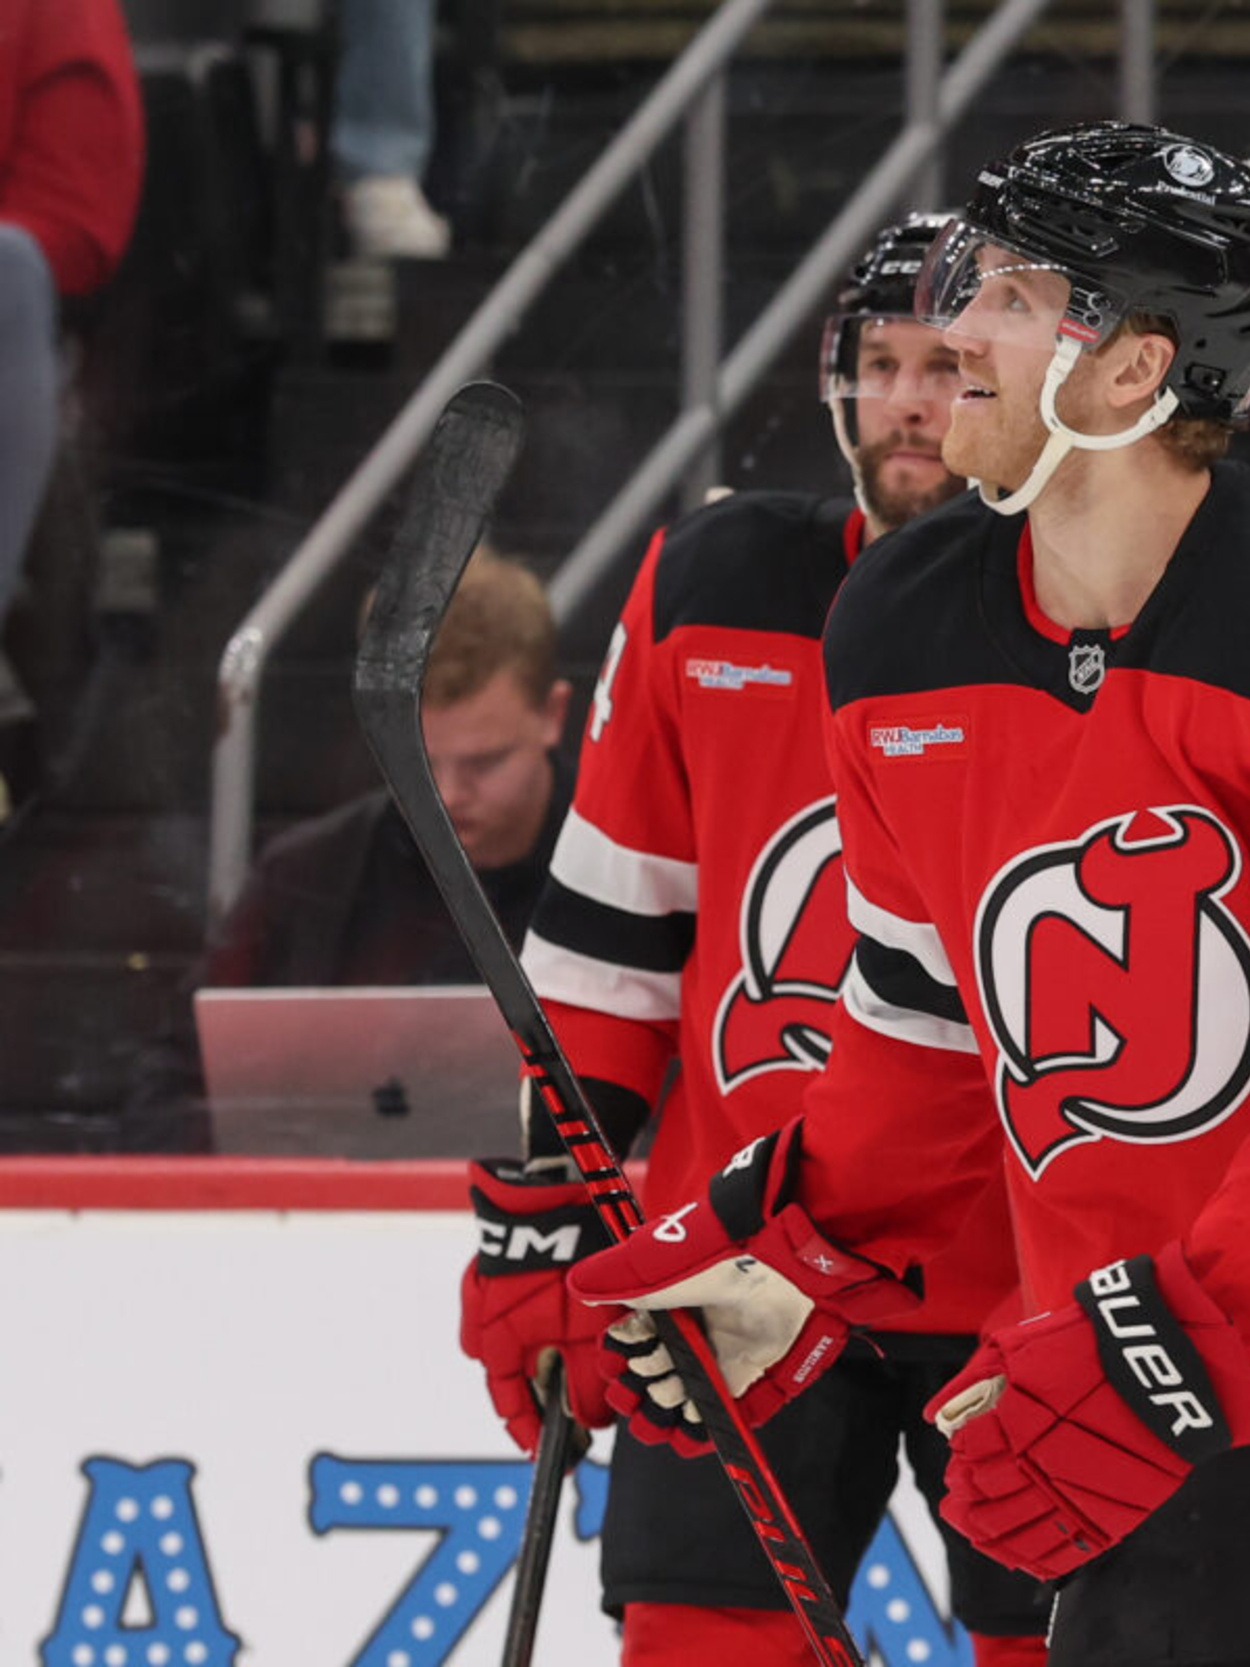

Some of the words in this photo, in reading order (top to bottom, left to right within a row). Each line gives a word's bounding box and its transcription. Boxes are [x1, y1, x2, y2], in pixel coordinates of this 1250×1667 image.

[880, 260, 924, 275] CC
[477, 1219, 582, 1261] CM
[1088, 1258, 1214, 1437] AUER
